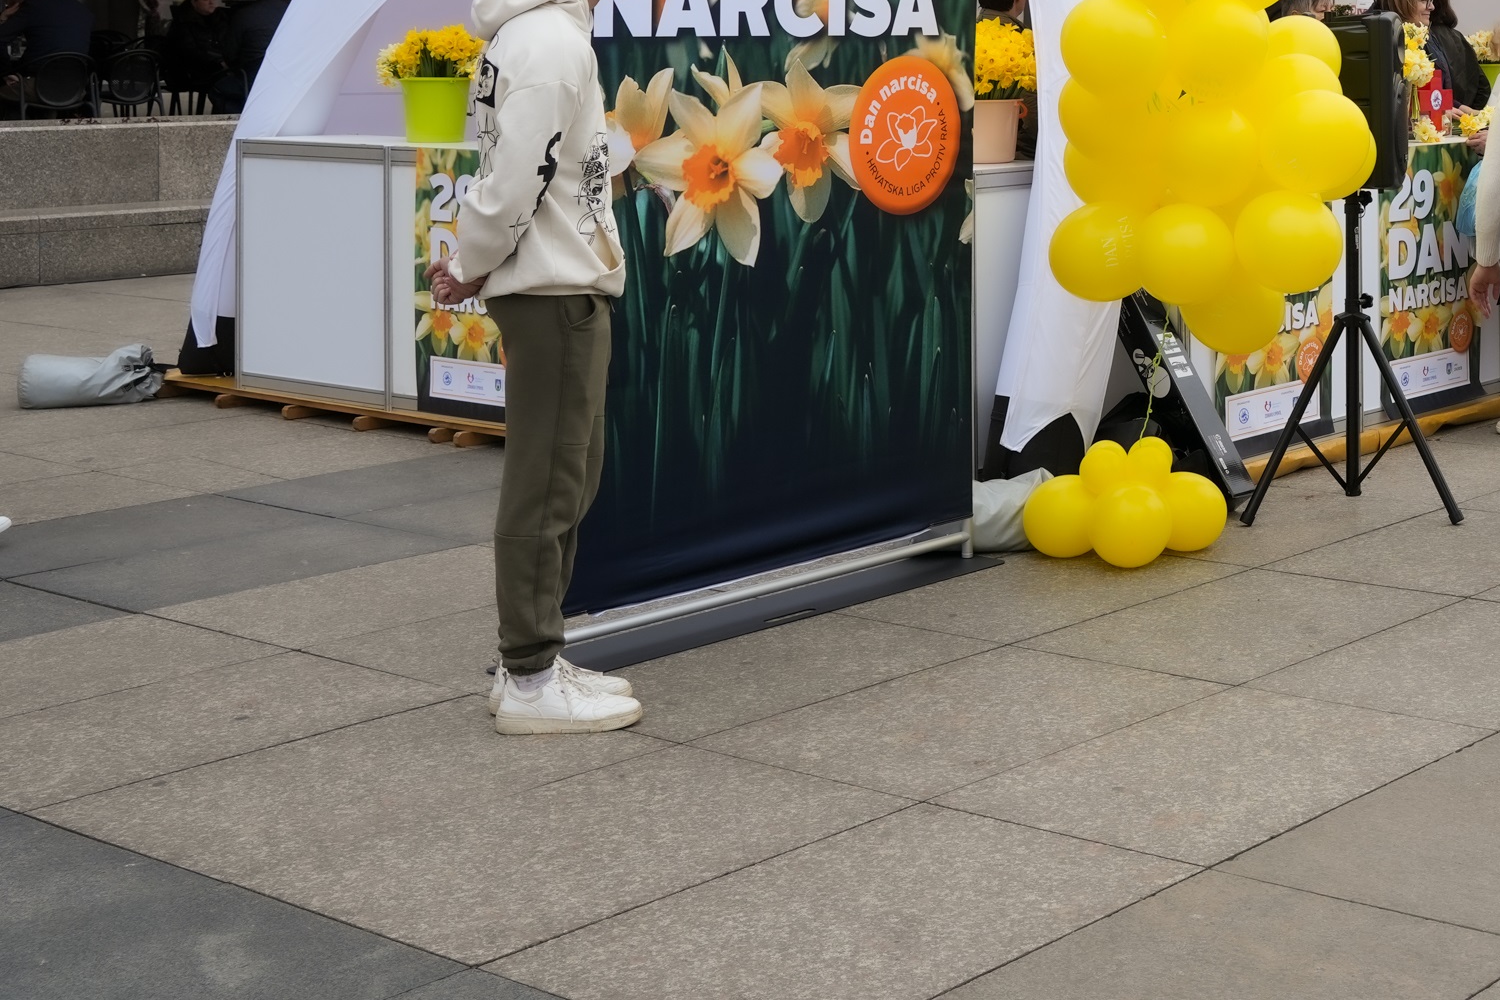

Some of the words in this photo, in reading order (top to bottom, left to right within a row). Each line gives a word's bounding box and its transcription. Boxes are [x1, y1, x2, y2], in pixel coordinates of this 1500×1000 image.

[860, 99, 881, 145] Dan
[879, 73, 938, 104] narcisa
[867, 158, 904, 197] HRVATSKA
[906, 184, 927, 196] LIGA
[926, 145, 947, 184] PROTIV
[939, 108, 948, 141] RAKA
[1389, 220, 1469, 280] DAN
[1389, 274, 1469, 313] NARCISA
